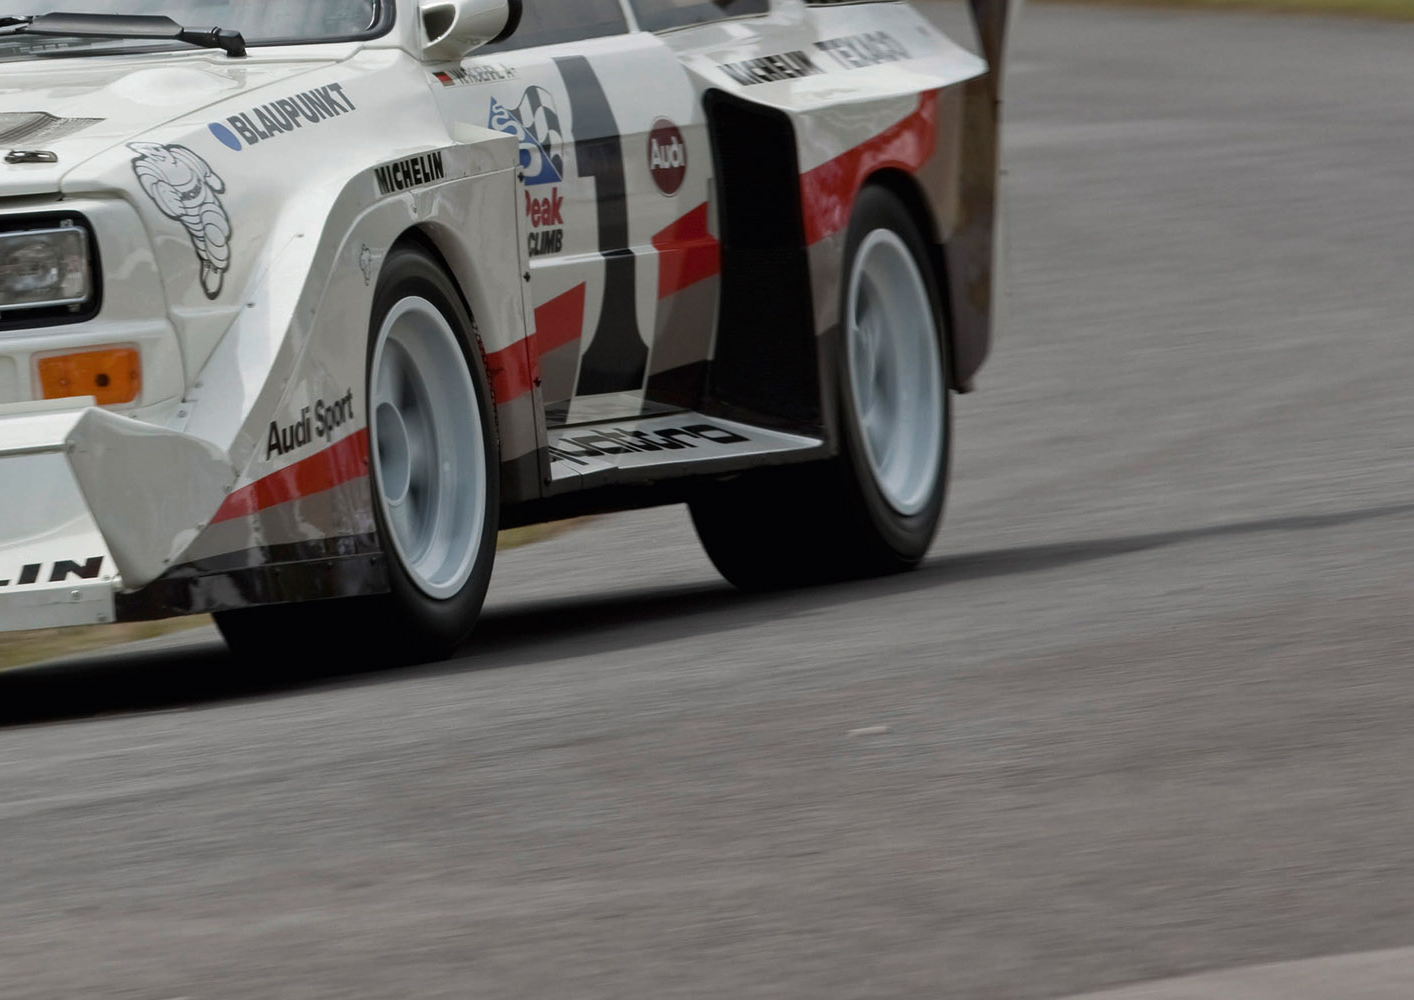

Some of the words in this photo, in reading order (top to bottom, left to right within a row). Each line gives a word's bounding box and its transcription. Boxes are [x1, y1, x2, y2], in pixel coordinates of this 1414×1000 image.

[226, 82, 356, 146] BLAUPUNKT
[374, 151, 445, 196] MICHELIN
[650, 135, 685, 169] Audi
[528, 228, 564, 258] CLIMB
[266, 405, 313, 461] Audi
[314, 386, 354, 443] Sport
